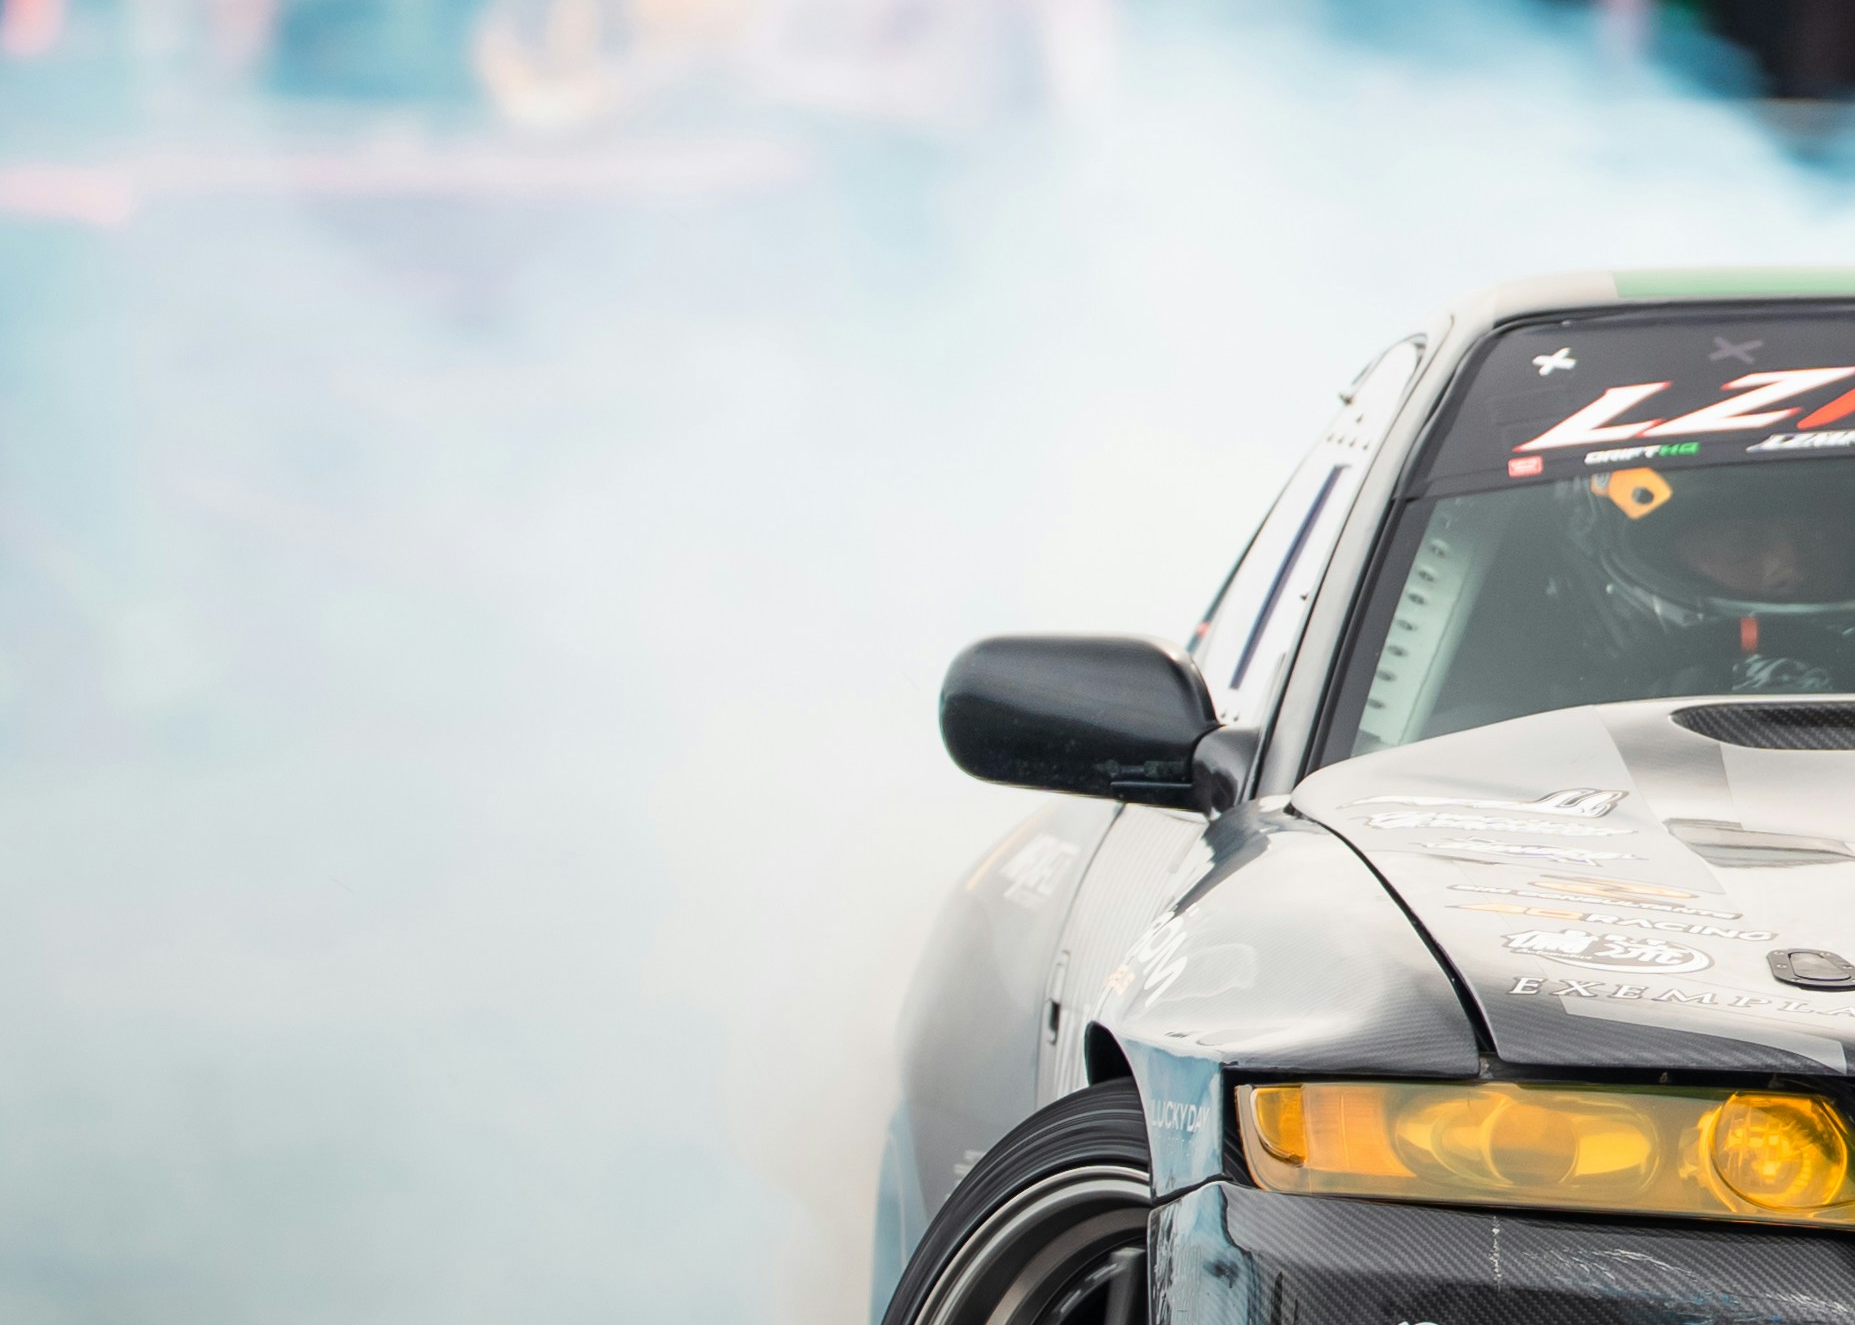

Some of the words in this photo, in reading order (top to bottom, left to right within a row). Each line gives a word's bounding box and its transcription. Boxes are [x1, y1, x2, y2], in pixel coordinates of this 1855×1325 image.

[1582, 912, 1779, 942] RACING
[1151, 1099, 1187, 1132] LUCKY
[1188, 1104, 1211, 1134] DAY
